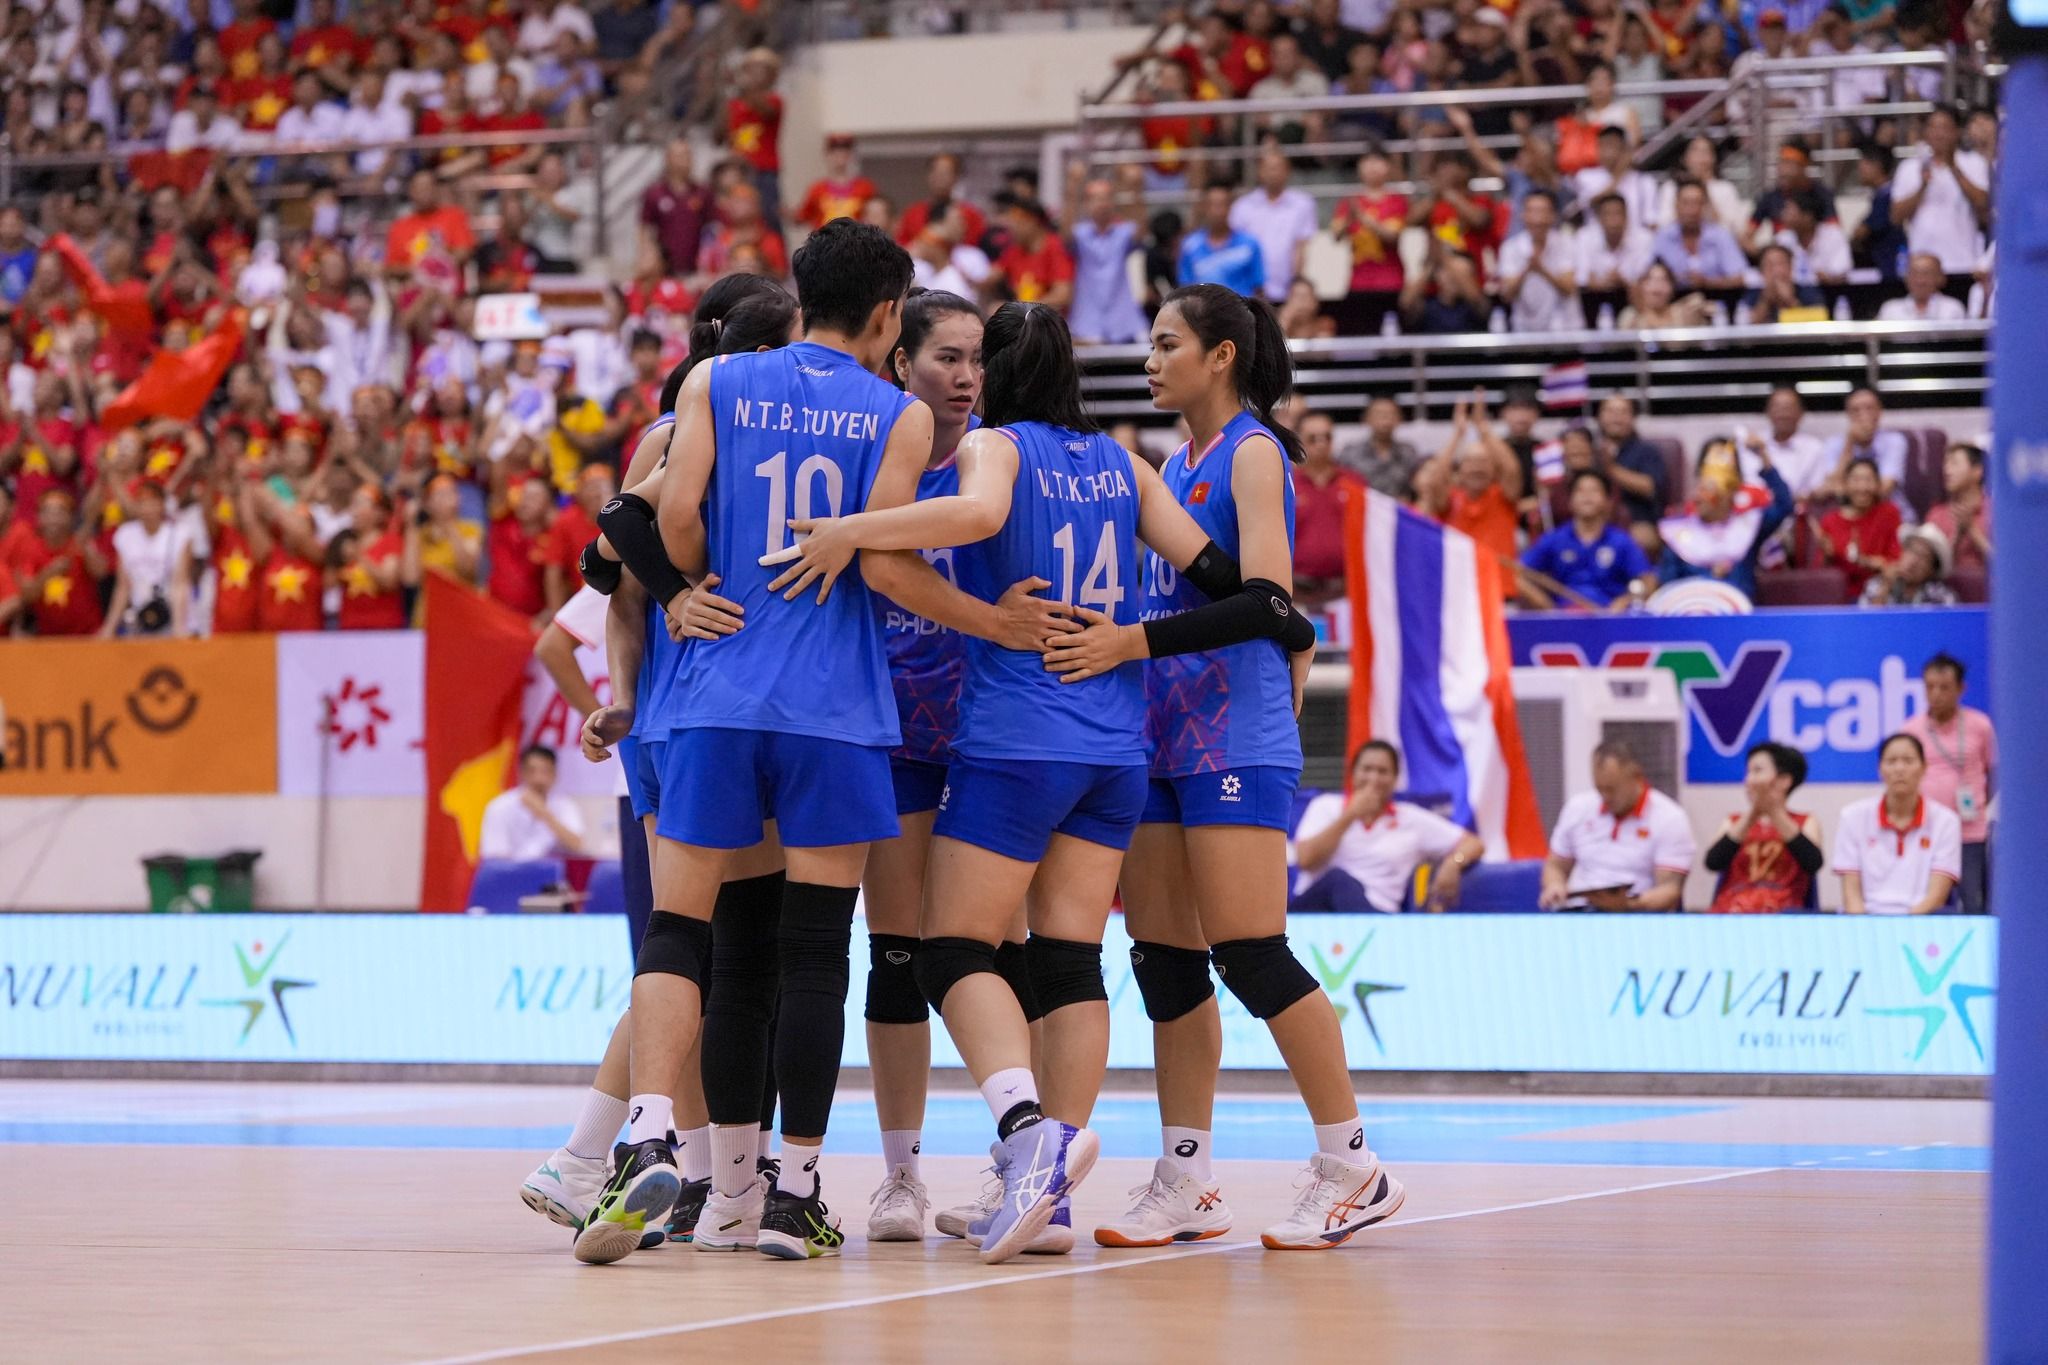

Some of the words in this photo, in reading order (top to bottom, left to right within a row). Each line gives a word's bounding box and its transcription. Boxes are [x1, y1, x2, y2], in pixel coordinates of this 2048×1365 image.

[755, 451, 843, 554] 10
[1053, 520, 1124, 623] 14
[495, 966, 632, 1014] NUV
[1608, 969, 1861, 1018] NUVALI
